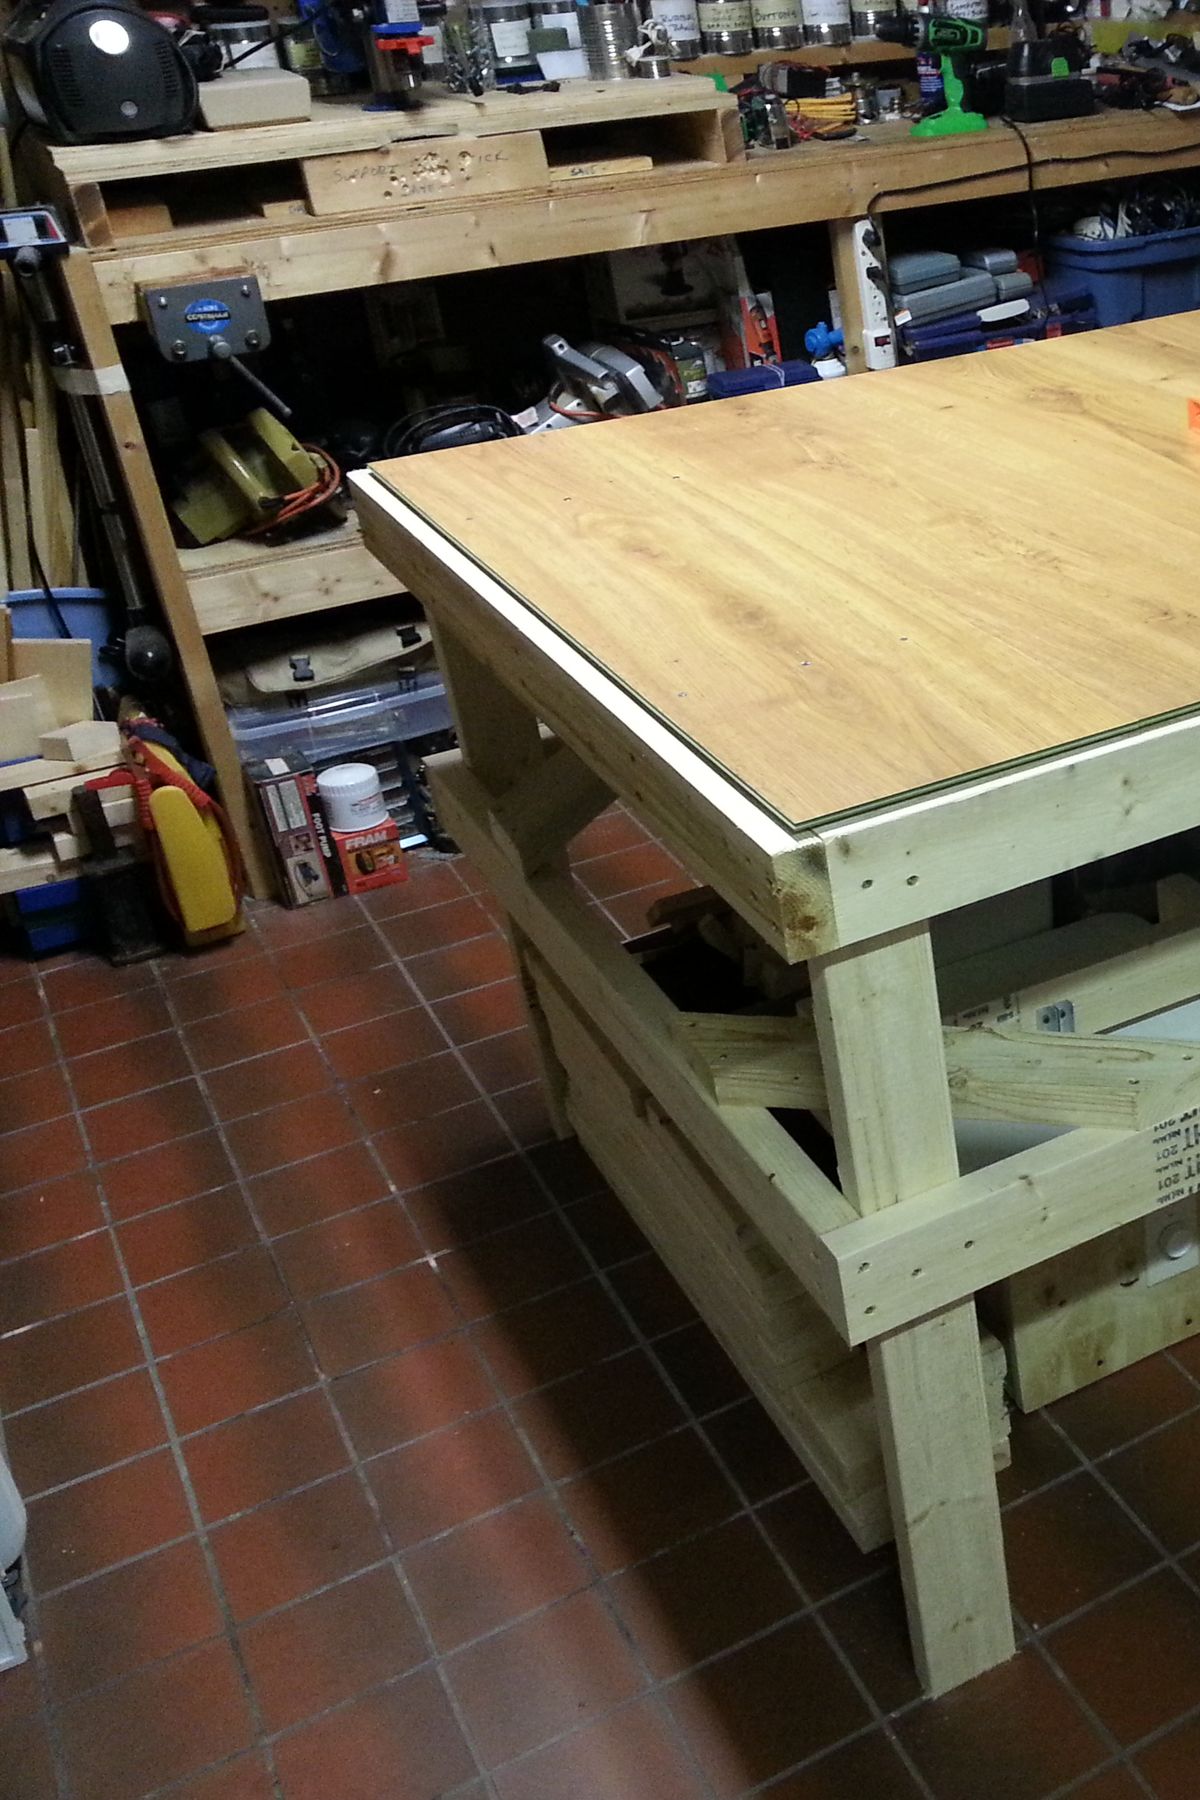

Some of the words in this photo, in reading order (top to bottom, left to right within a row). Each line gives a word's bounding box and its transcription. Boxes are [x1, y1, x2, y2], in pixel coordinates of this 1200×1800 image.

[312, 812, 326, 834] FOOT
[318, 835, 332, 858] PUMP
[345, 830, 387, 850] FRAM
